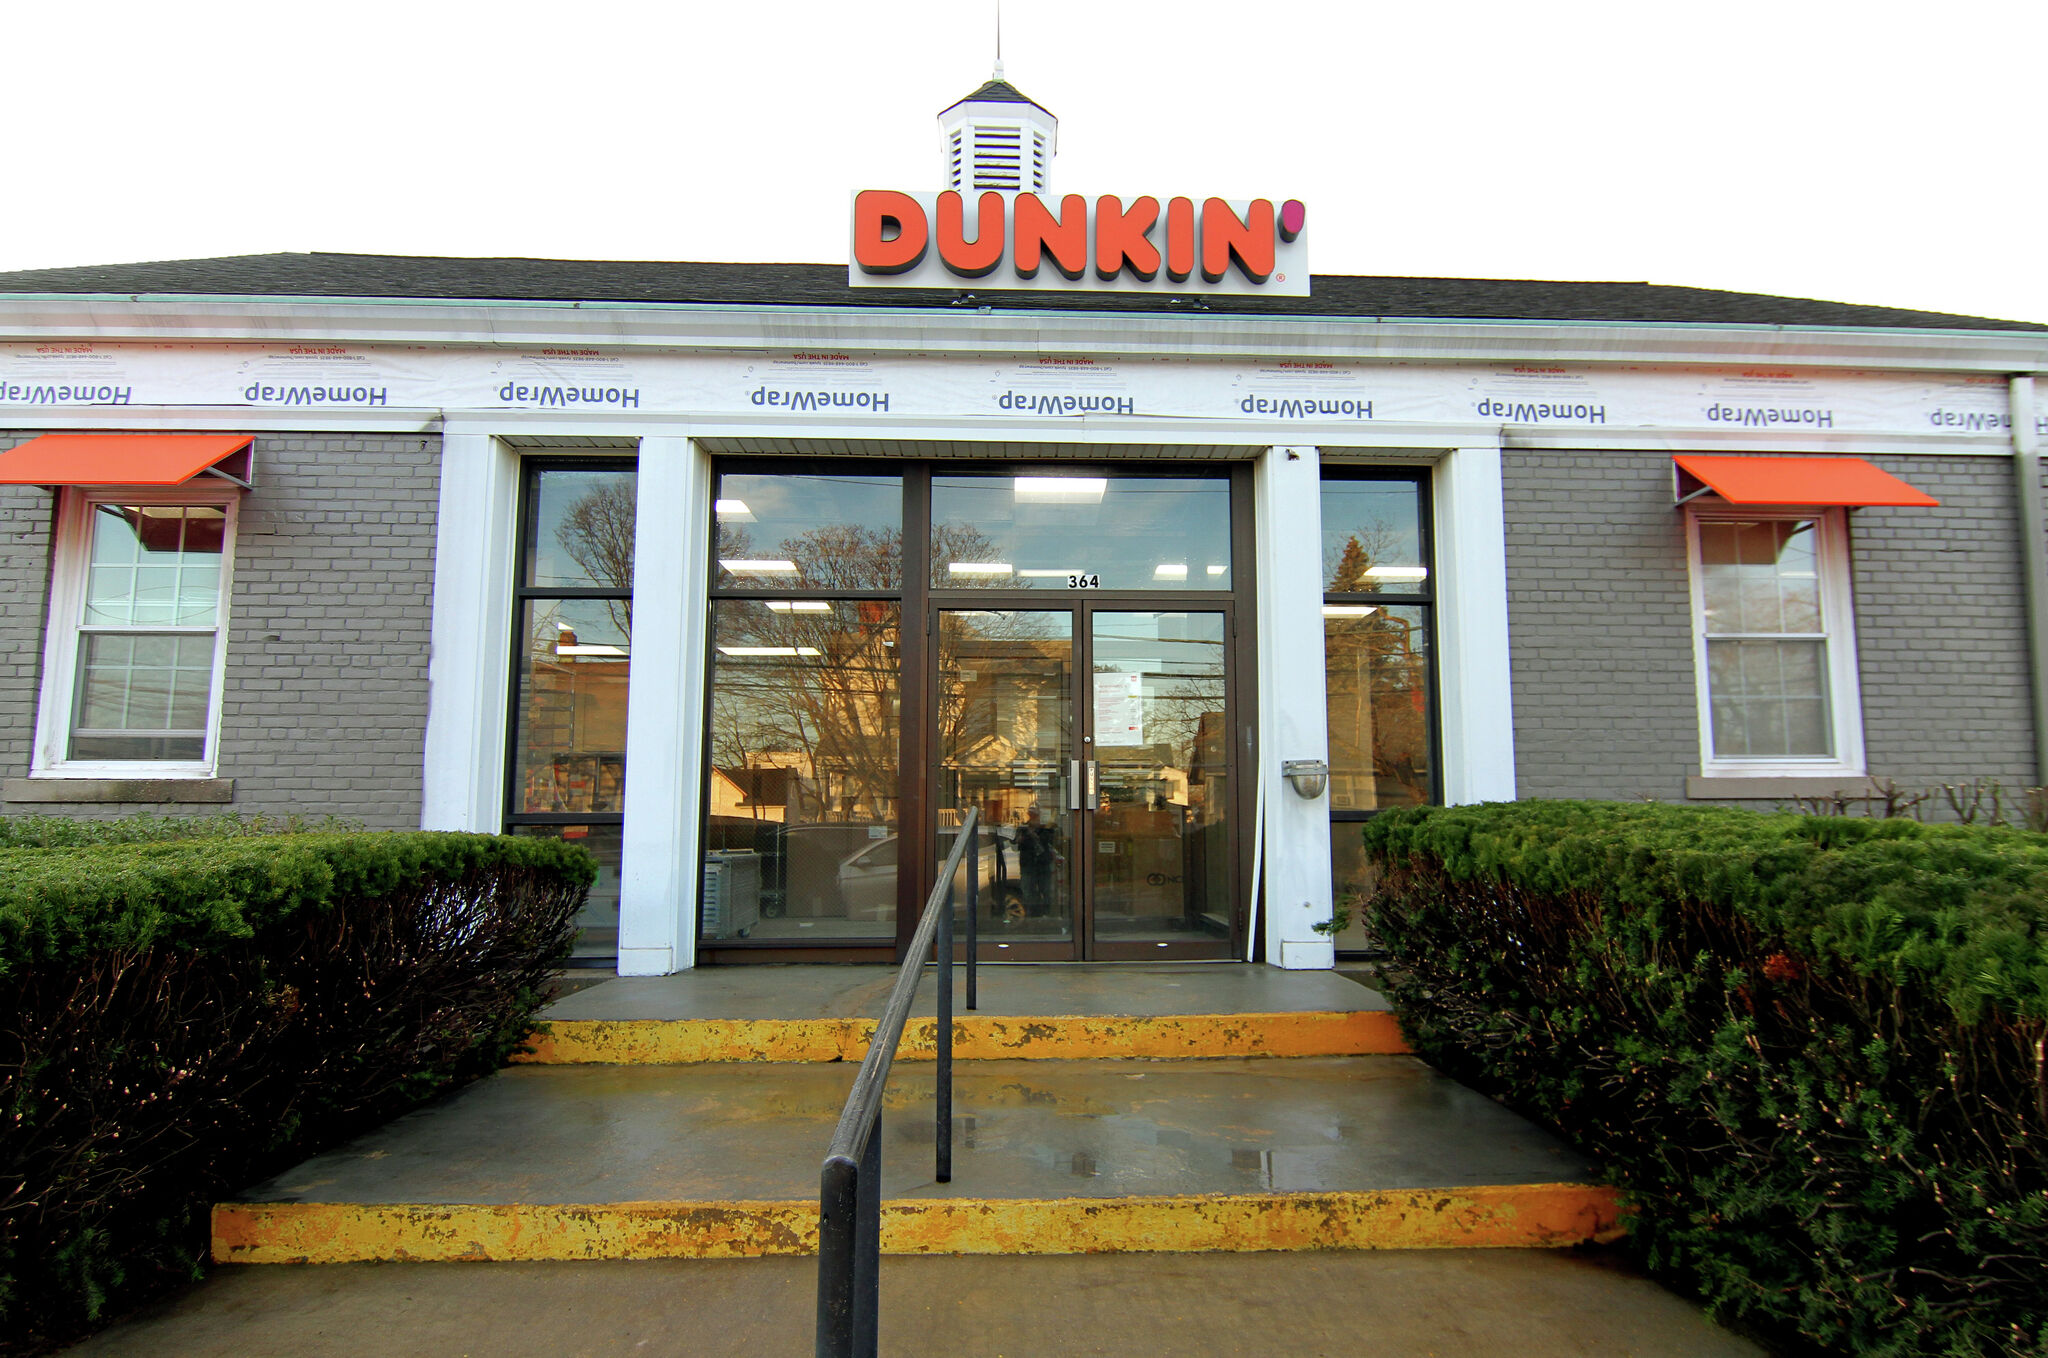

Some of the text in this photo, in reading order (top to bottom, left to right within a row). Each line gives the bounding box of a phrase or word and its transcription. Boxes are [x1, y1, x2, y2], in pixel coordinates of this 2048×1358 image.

[854, 190, 1305, 281] DUNKIN'
[245, 382, 387, 405] HomeWrap
[500, 382, 639, 408] HomeWrap
[751, 387, 889, 412] HomeWrap
[999, 391, 1134, 415] HomeWrap
[1241, 395, 1373, 419] HomeWrap
[1477, 398, 1605, 424] HomeWrap
[1707, 403, 1833, 428] HomeWrap
[1069, 575, 1099, 588] 364
